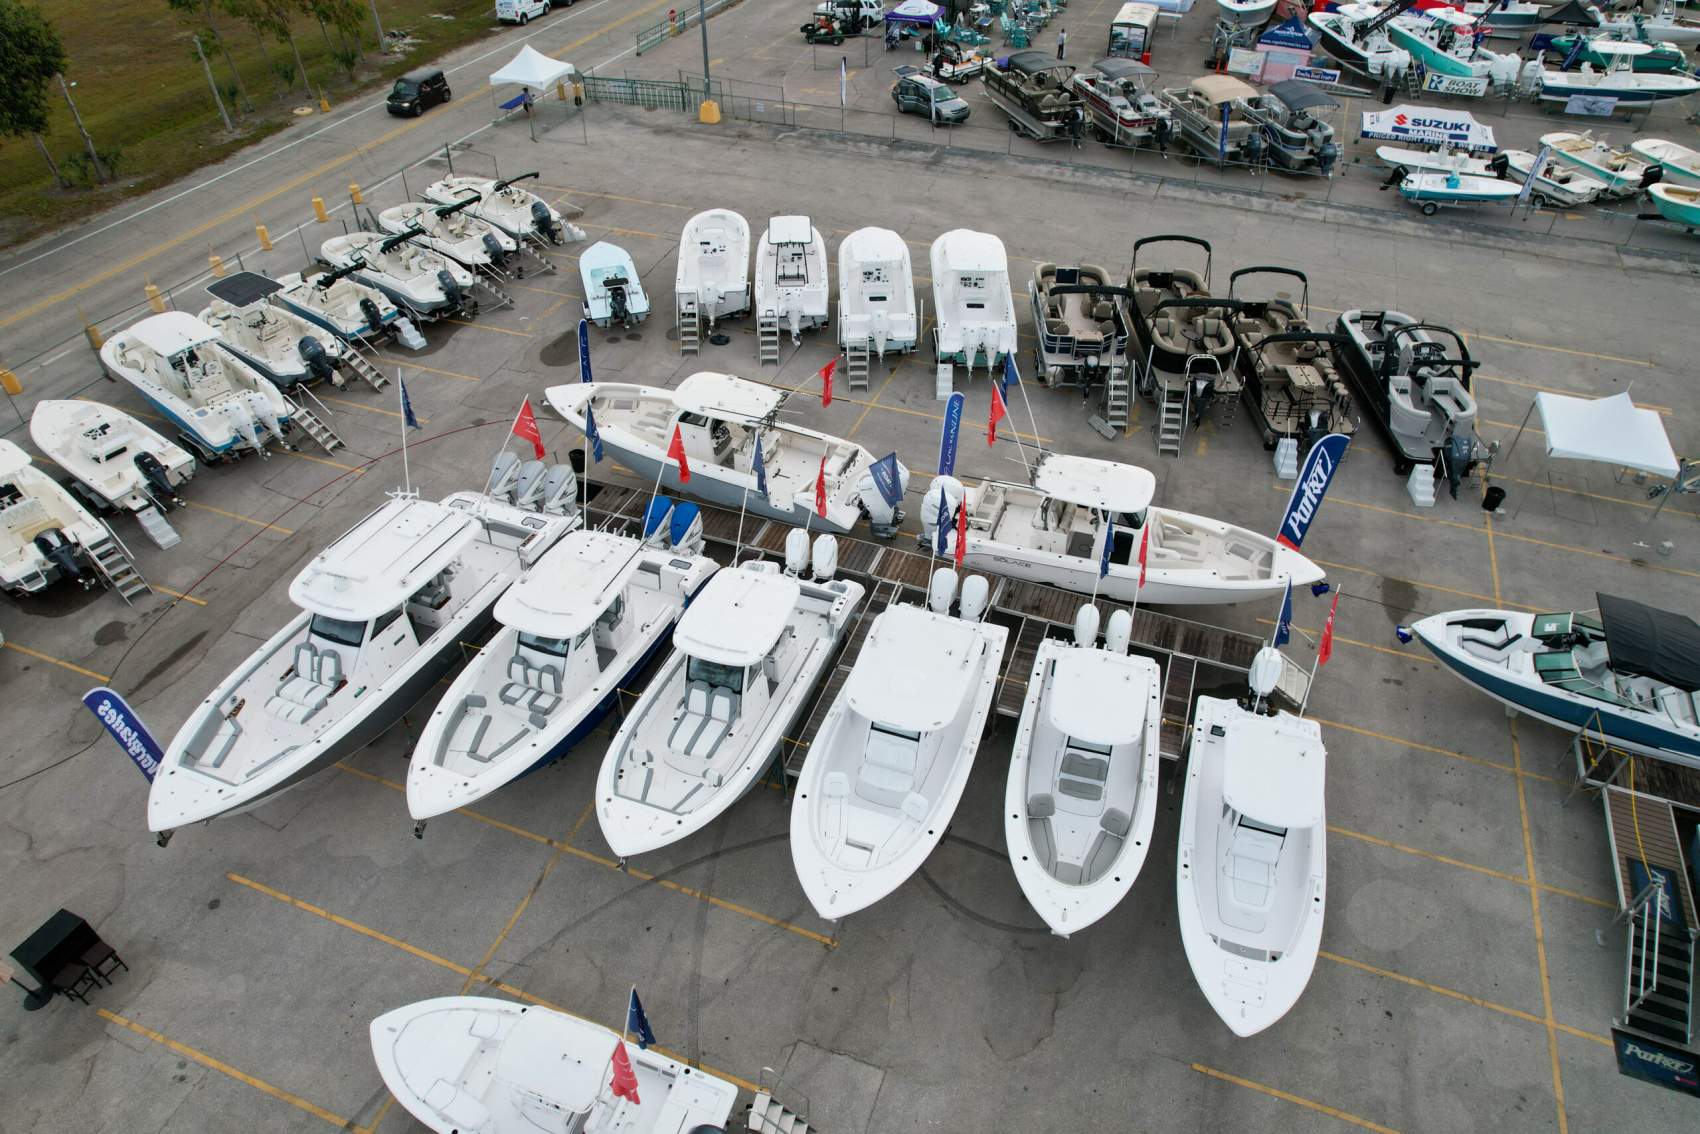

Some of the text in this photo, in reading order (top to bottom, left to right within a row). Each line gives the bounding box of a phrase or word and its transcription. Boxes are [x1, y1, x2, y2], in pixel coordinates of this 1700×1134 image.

[1448, 79, 1480, 89] BOAT
[1443, 86, 1481, 95] SHOW
[1411, 118, 1471, 133] SUZUKI
[1408, 128, 1450, 140] MARINE
